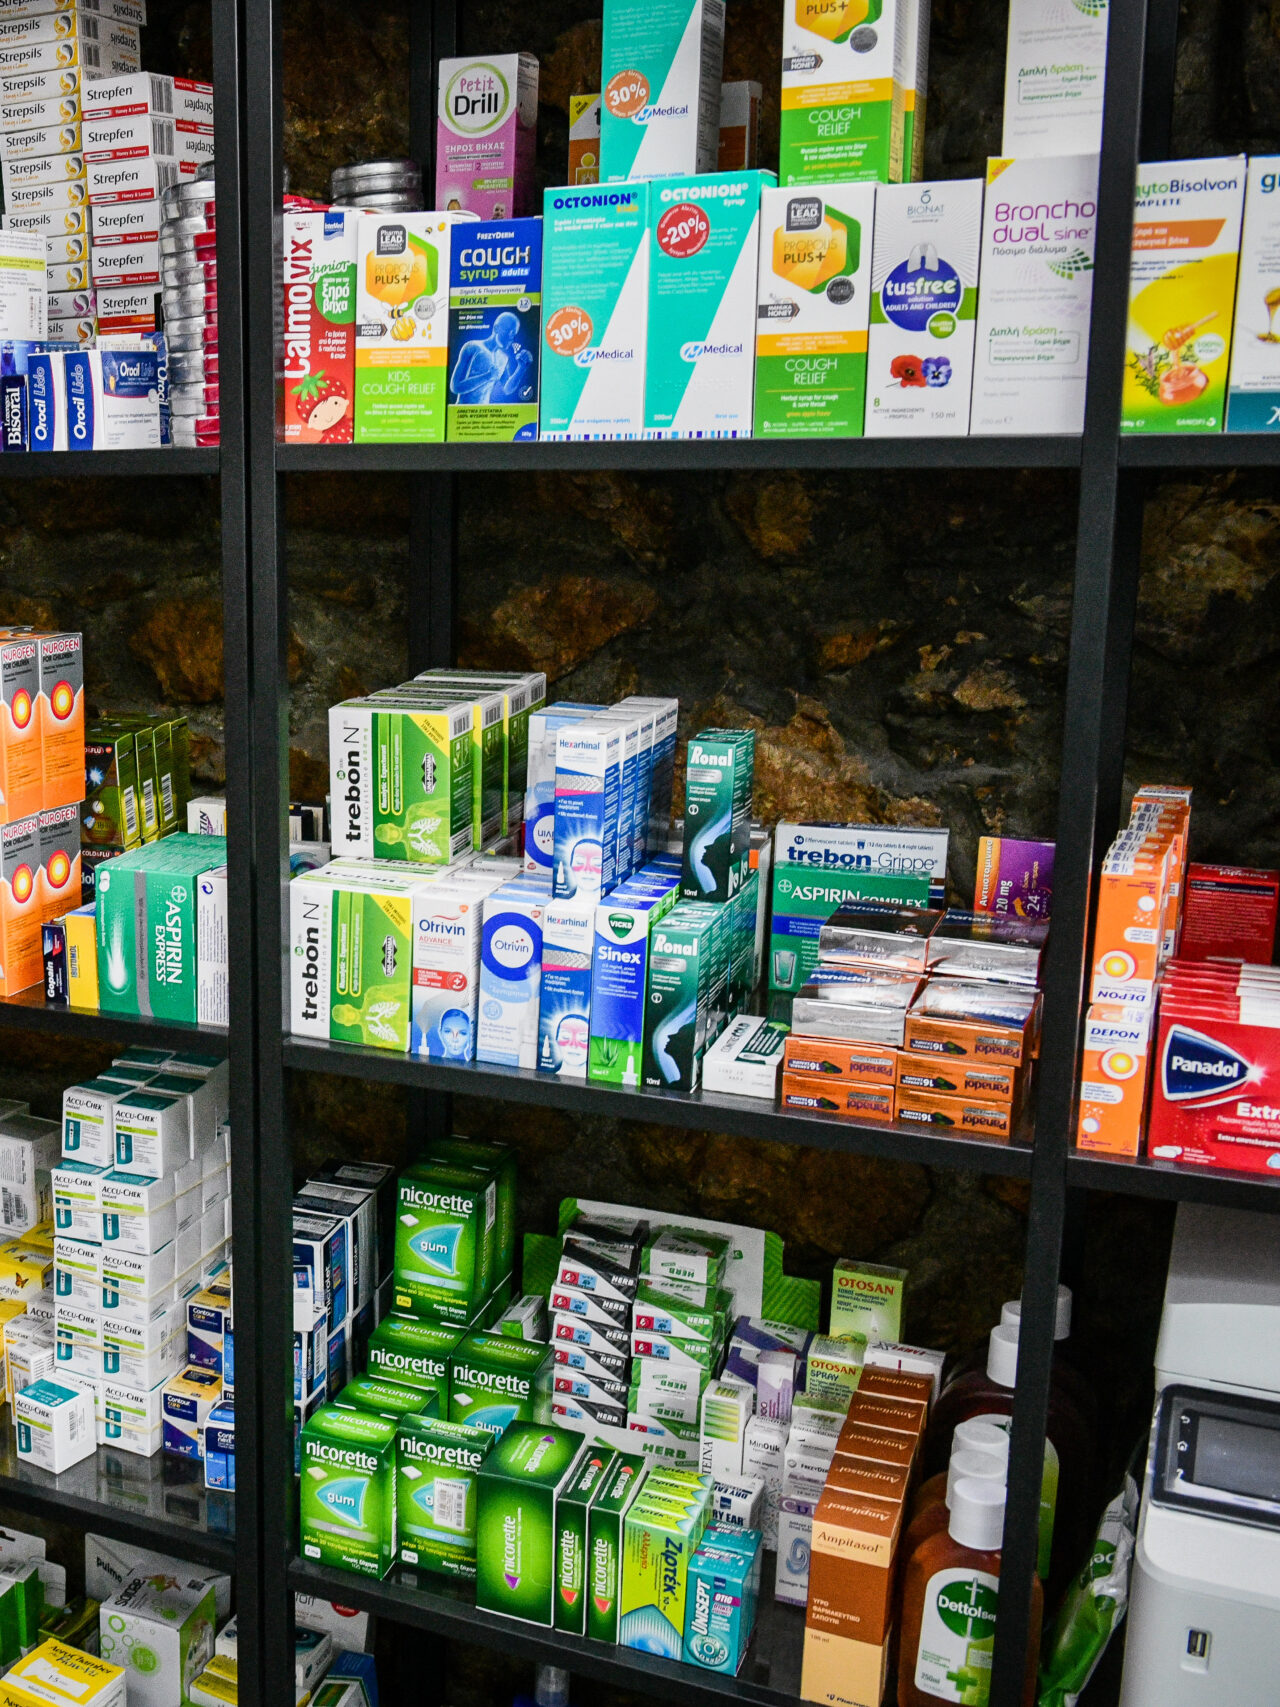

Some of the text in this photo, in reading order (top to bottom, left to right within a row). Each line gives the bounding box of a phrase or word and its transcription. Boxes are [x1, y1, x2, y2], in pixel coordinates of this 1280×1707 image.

[0, 48, 42, 63] Strepsils
[3, 77, 46, 91] Strepsils
[87, 86, 133, 101] Strepfen
[609, 81, 646, 106] 30%
[2, 104, 45, 118] Strepsils
[455, 93, 498, 116] Drill
[652, 105, 688, 117] Medical
[809, 107, 861, 125] COUGH
[88, 128, 134, 143] Strepfen
[817, 123, 851, 137] RELIEF
[6, 133, 47, 147] Strepsils
[94, 171, 139, 185] Strepfen
[791, 209, 818, 218] LEAD
[995, 200, 1096, 222] Broncho
[98, 213, 143, 227] Strepfen
[662, 214, 707, 244] -20%
[993, 222, 1088, 243] dual sine
[380, 235, 404, 244] LEAD
[460, 246, 530, 267] COUGH
[784, 252, 826, 263] PLUS+
[375, 275, 410, 285] PLUS+
[460, 267, 530, 281] syrup adults
[885, 277, 957, 296] tusfree
[768, 309, 793, 317] HONEY
[885, 304, 909, 312] ADULTS
[550, 316, 589, 346] 30%
[595, 350, 633, 360] Medical
[704, 344, 743, 354] Medical
[785, 358, 837, 372] COUGH
[388, 371, 410, 382] KIDS
[794, 372, 827, 385] RELIEF
[362, 383, 436, 395] COUGH RELIEF
[34, 367, 47, 440] Orocil Lido
[72, 364, 86, 439] Orocil Lido
[8, 387, 20, 445] Bisoral
[3, 645, 35, 662] NUROFEN
[42, 639, 80, 654] NUROFEN
[559, 739, 600, 750] Hexarhinal
[690, 746, 733, 767] Ronal
[343, 726, 361, 842] trebon N
[791, 886, 860, 903] ASPIRIN
[419, 919, 465, 937] Otrivin
[547, 915, 587, 928] Hexarhinal
[610, 919, 633, 929] VICKS
[165, 901, 182, 984] ASPIRIN
[419, 936, 452, 945] ADVANCE
[495, 938, 529, 953] Otrivin
[654, 934, 698, 957] Ronal
[155, 925, 165, 986] EXPRESS
[301, 902, 319, 1021] trebon N
[598, 945, 641, 965] Sinex
[47, 961, 55, 998] Gopain
[1097, 988, 1146, 1002] DEPON
[1091, 1027, 1140, 1040] DEPON
[974, 1043, 1020, 1059] Panadol
[850, 1061, 893, 1077] Panadol
[66, 1096, 102, 1111] ACCU-CHEK
[847, 1099, 889, 1114] Panadol
[116, 1110, 156, 1123] ACCU-CHEK
[54, 1174, 92, 1187] ACCU-CHEK
[400, 1186, 473, 1214] nicorette
[420, 1240, 448, 1254] gum
[611, 1275, 634, 1287] HERB
[838, 1277, 894, 1295] OTOSAN
[192, 1307, 215, 1318] Contour
[602, 1301, 625, 1311] HERB
[371, 1348, 445, 1377] nicorette
[600, 1356, 623, 1366] HERB
[810, 1360, 856, 1376] OTOSAN
[454, 1364, 529, 1395] nicorette
[810, 1370, 838, 1381] SPRAY
[167, 1395, 191, 1406] Contour
[749, 1440, 780, 1453] MinOtik
[306, 1441, 377, 1471] nicorette
[327, 1491, 355, 1507] gum
[713, 1511, 744, 1525] RY EAR
[817, 1531, 880, 1553] Ampitasol
[691, 1578, 710, 1635] UNISEPT
